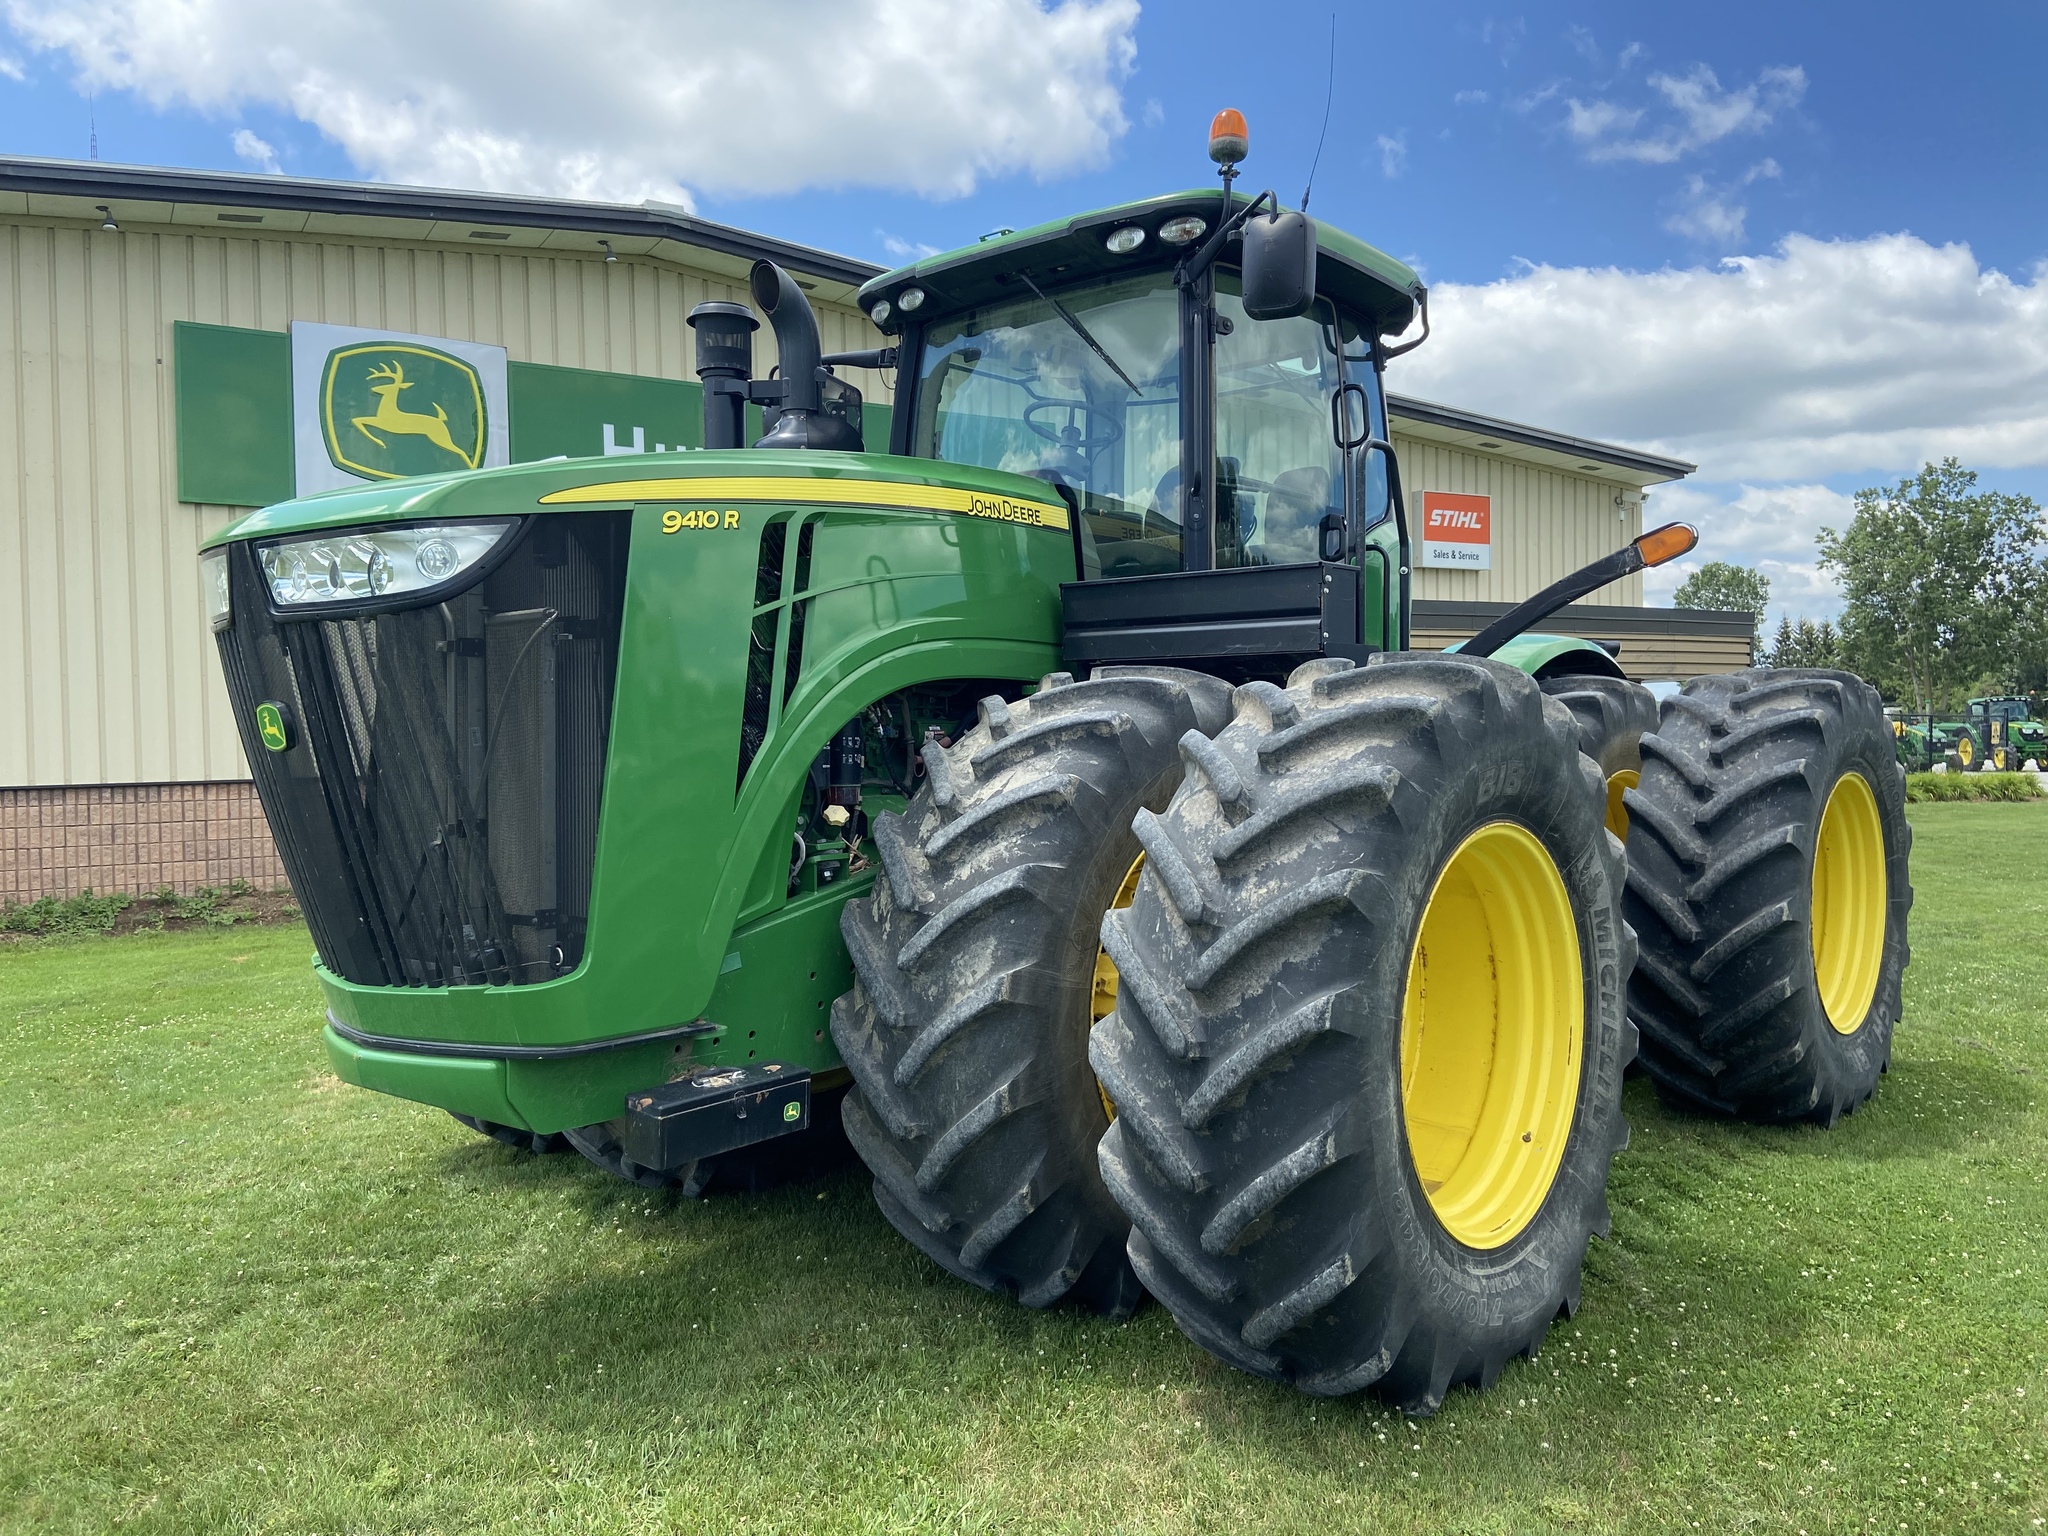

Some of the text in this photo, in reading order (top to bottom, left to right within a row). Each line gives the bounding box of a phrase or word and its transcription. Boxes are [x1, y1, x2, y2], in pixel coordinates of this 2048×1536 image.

[967, 495, 1042, 524] JOHN DEERE
[1428, 508, 1482, 529] STIHL
[661, 510, 740, 534] 9410 R
[1433, 549, 1480, 561] Sales & Service
[1590, 906, 1618, 1132] MICHELIN
